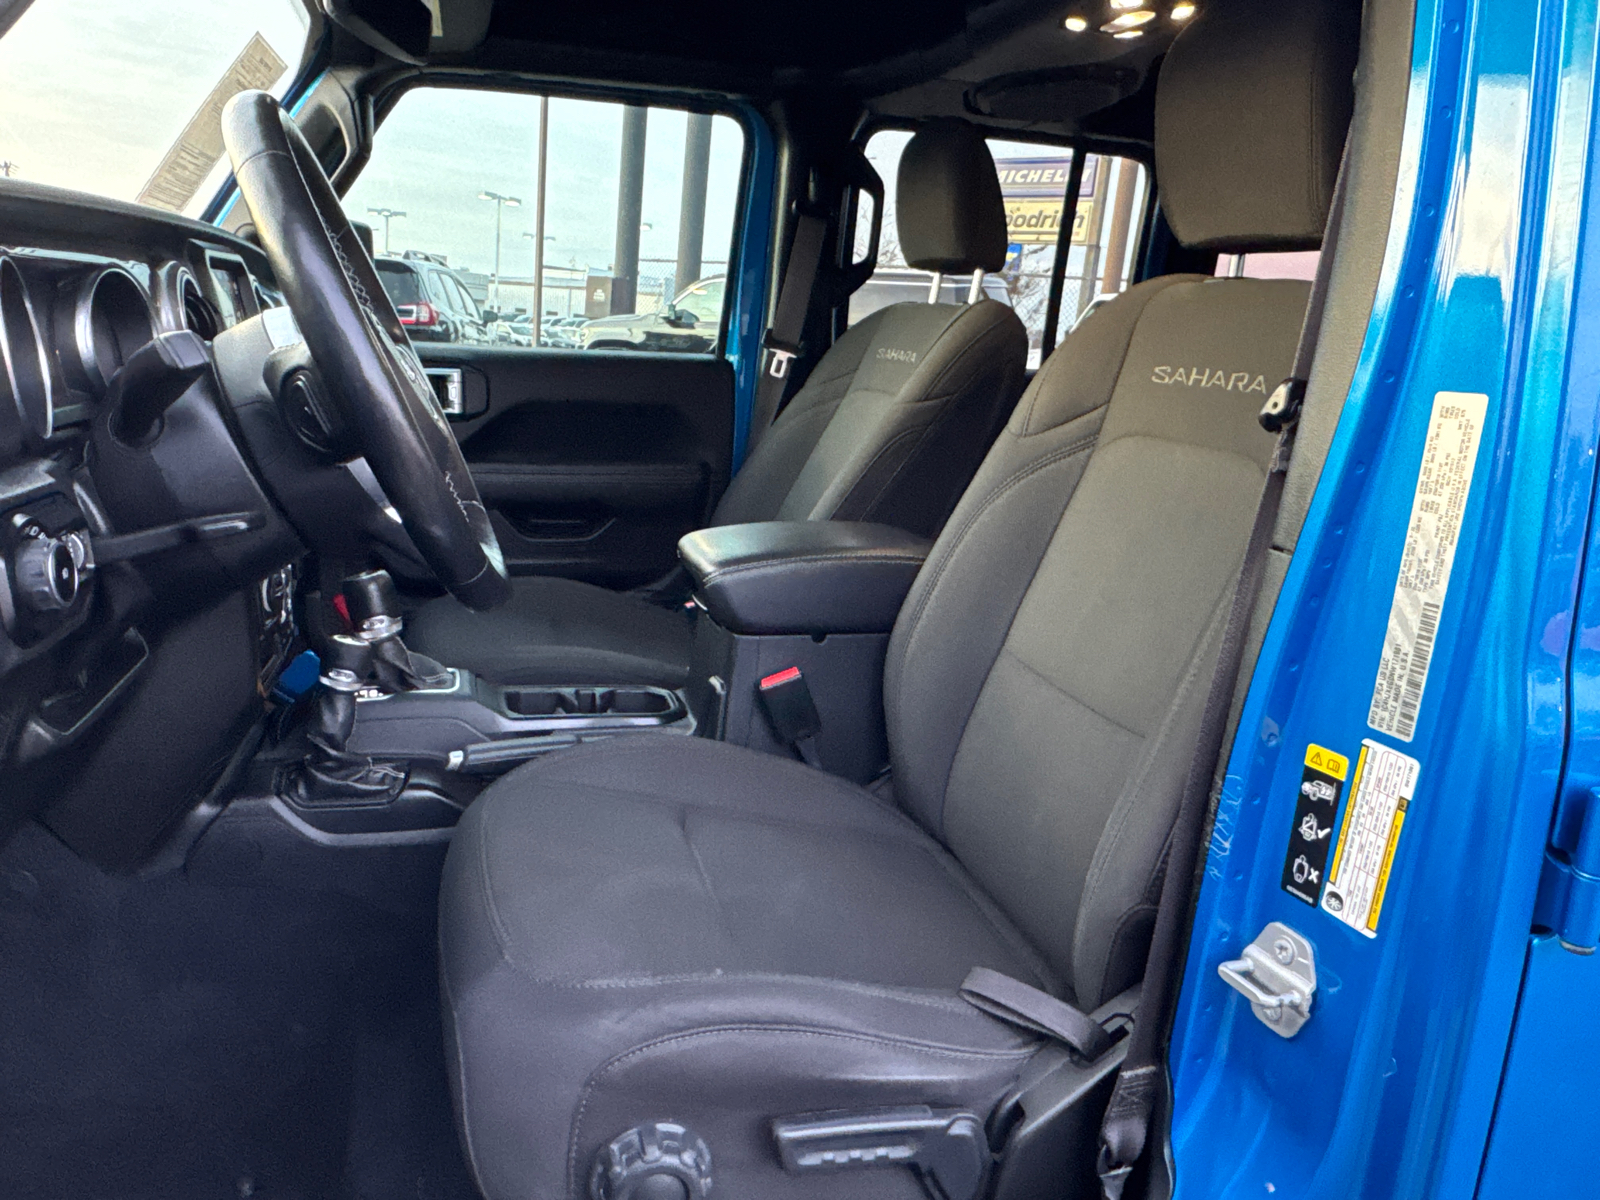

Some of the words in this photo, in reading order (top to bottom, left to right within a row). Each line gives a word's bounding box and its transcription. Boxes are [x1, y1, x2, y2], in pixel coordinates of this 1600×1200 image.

[998, 168, 1092, 184] MICHELN
[875, 347, 918, 364] SAHARA
[1151, 365, 1267, 395] SAHARA
[1392, 683, 1401, 703] MADE
